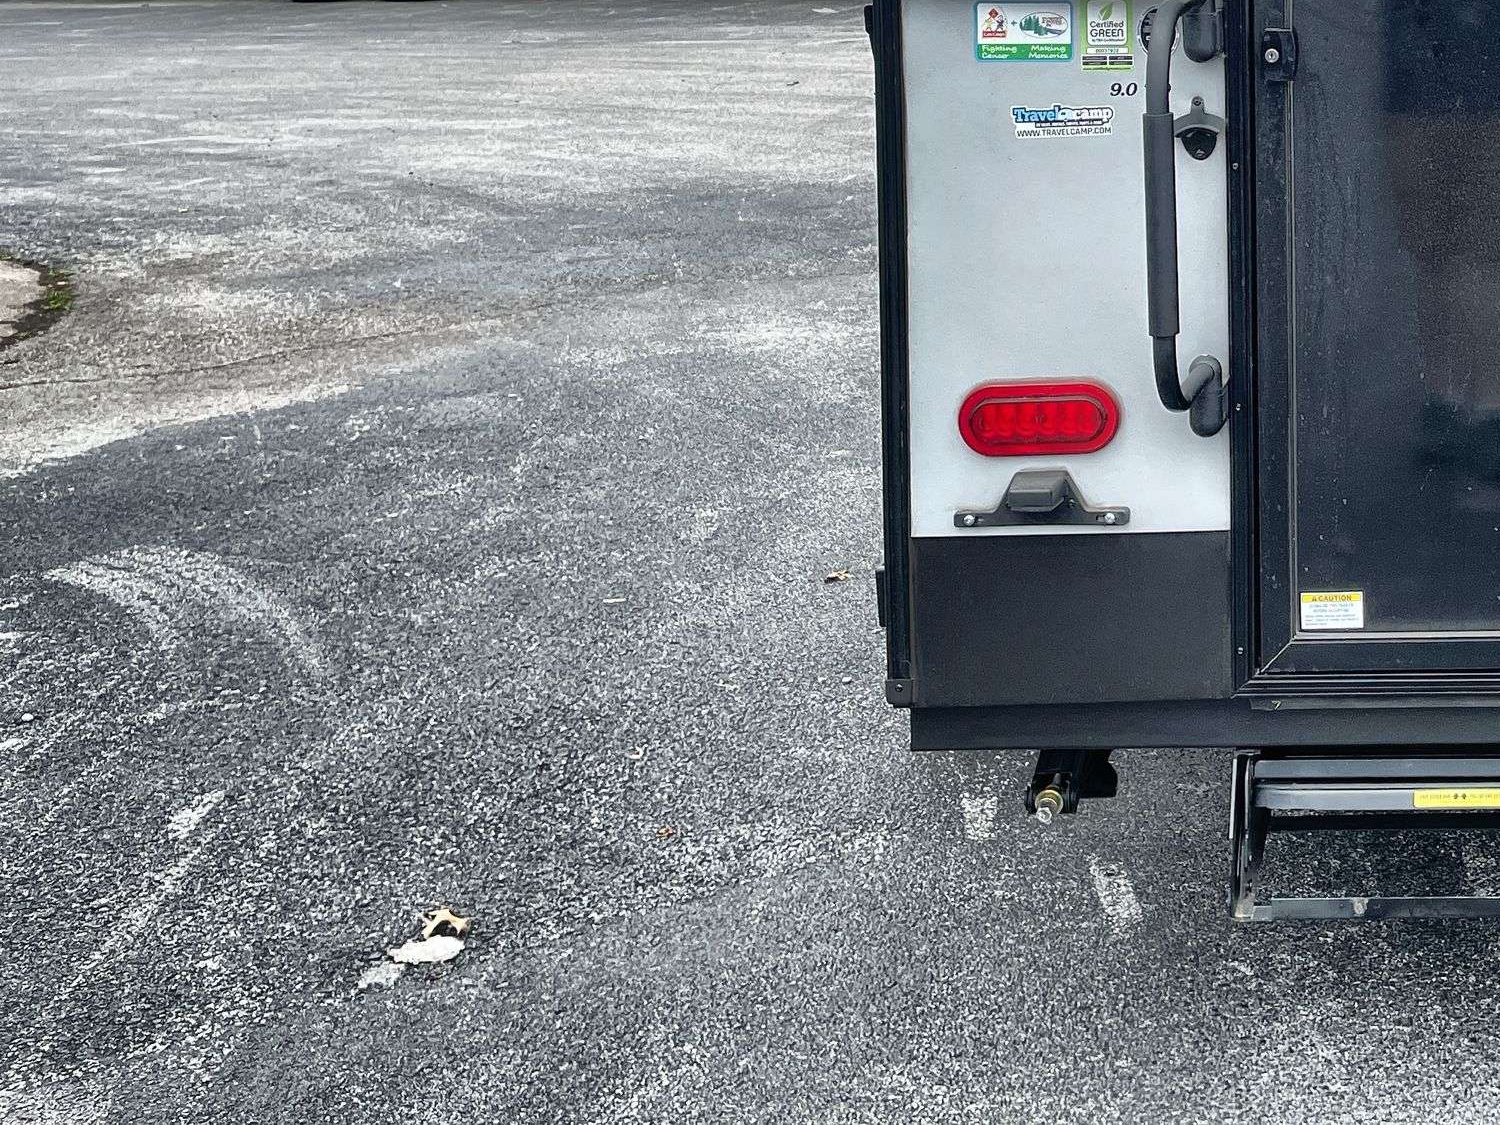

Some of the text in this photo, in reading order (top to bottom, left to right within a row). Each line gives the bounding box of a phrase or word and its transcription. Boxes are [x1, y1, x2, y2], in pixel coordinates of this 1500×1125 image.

[1089, 20, 1125, 28] Certified
[981, 45, 1018, 54] Fighting
[1030, 44, 1067, 53] Making
[1109, 82, 1138, 97] 9.0
[1016, 127, 1112, 137] WWW.TRAVELCAMP.COM
[1318, 594, 1352, 602] CAUTION
